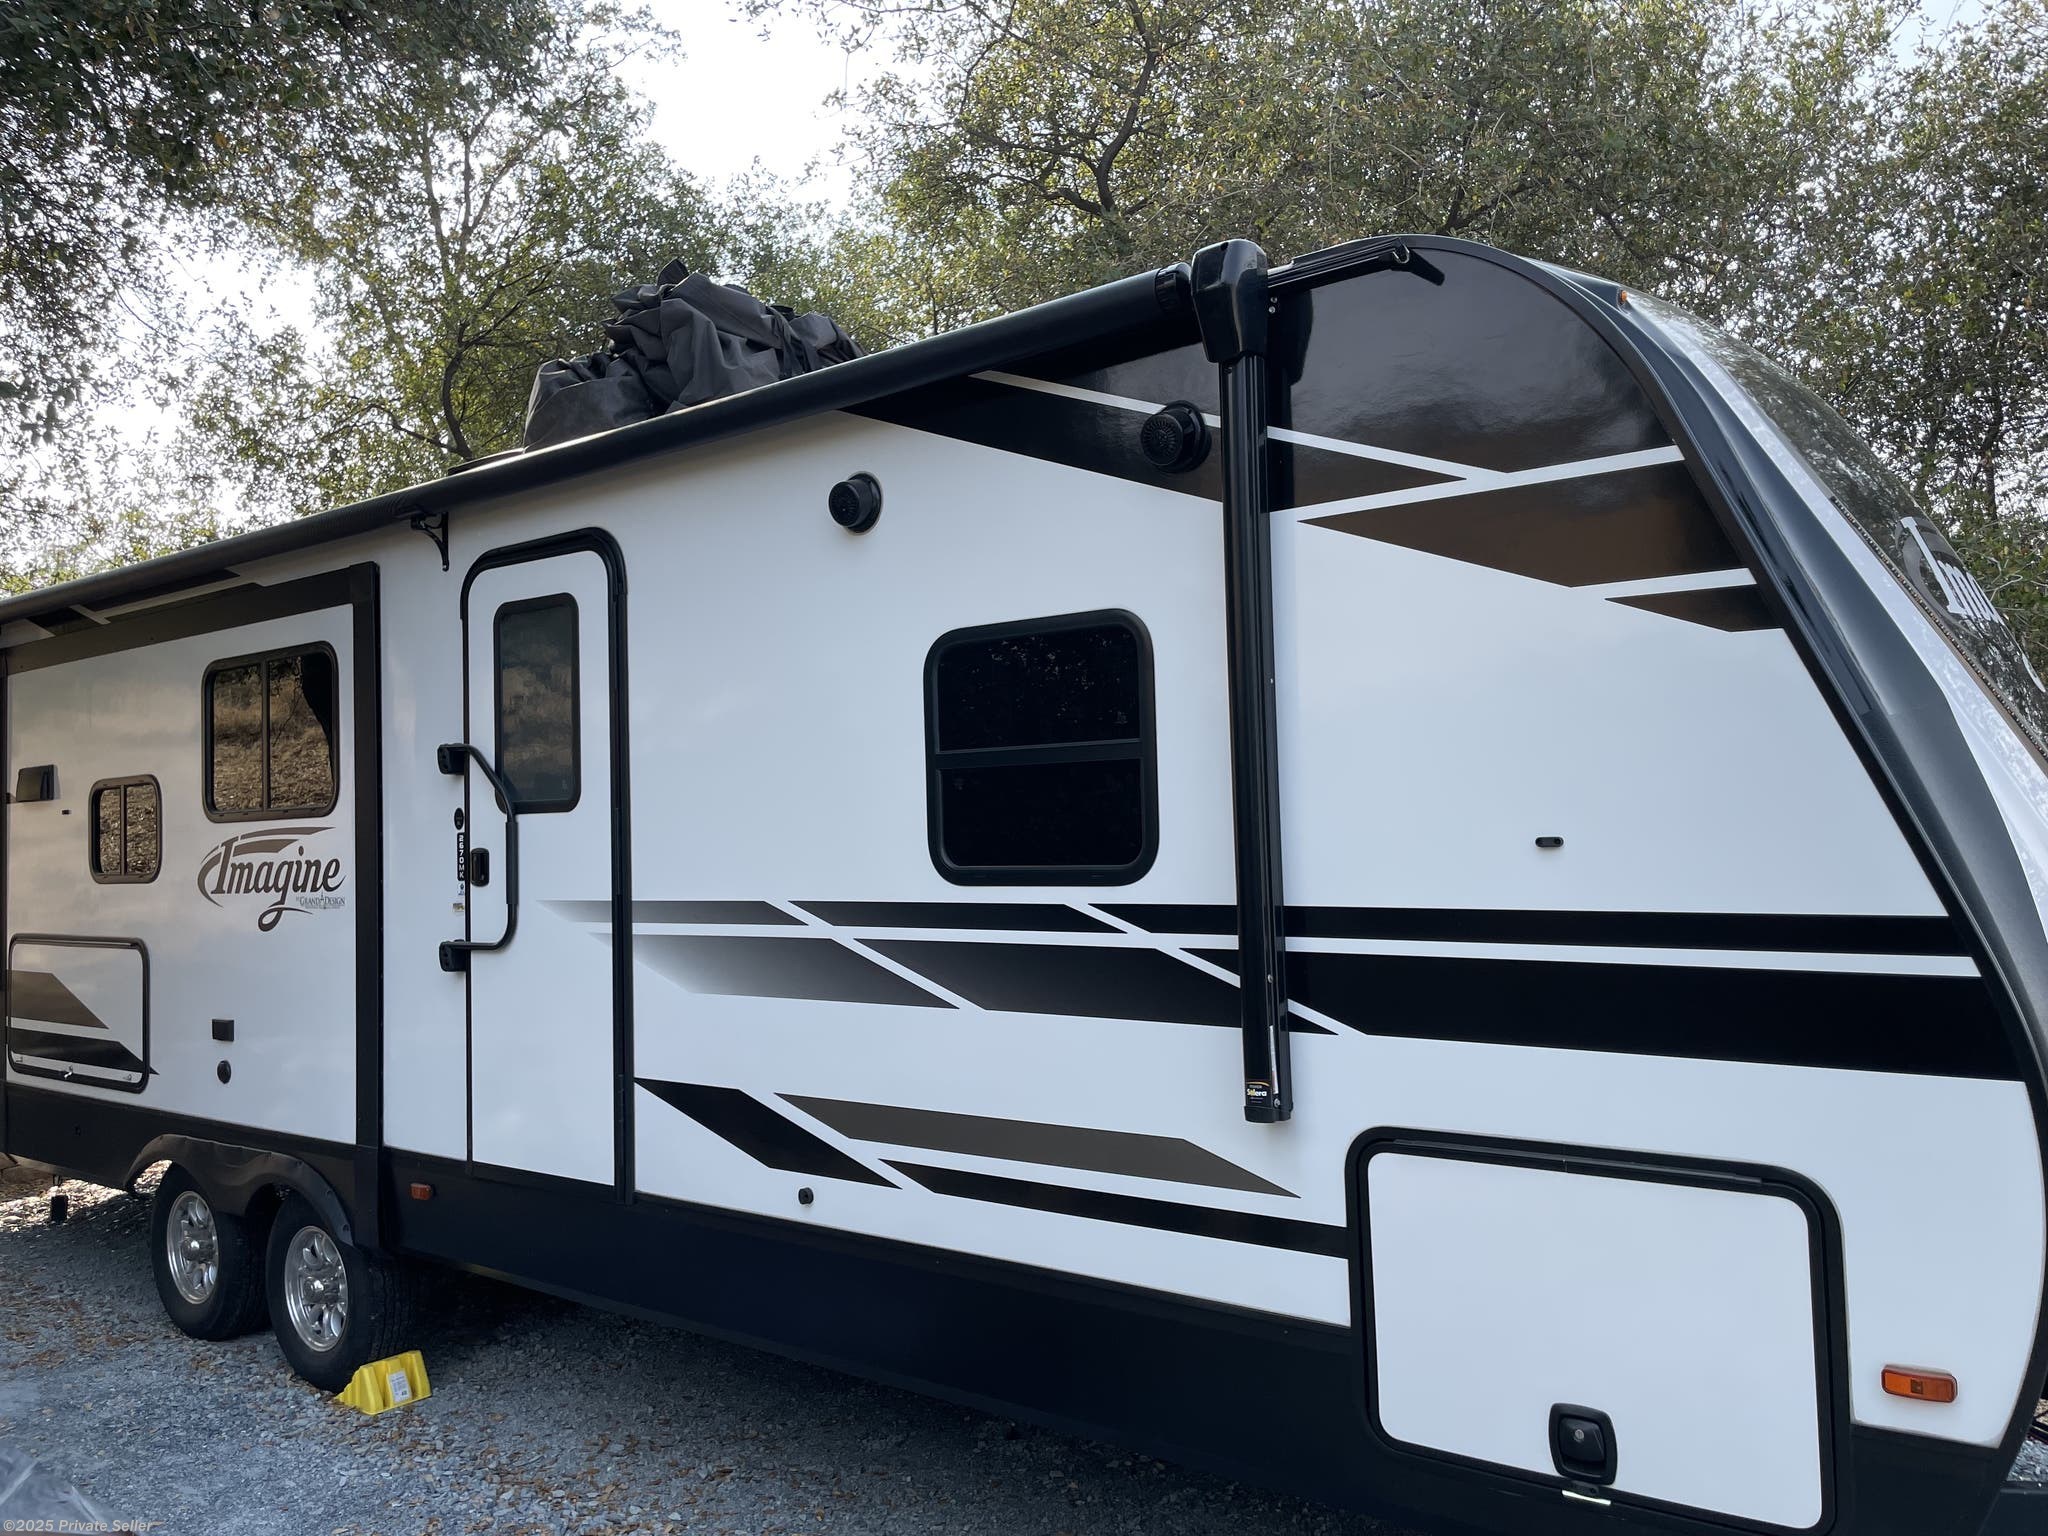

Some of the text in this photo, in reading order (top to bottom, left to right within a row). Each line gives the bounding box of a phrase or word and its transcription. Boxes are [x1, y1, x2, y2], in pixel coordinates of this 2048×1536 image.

[209, 835, 347, 932] Imagine
[299, 895, 322, 906] GRAND
[324, 895, 346, 906] DESIGN
